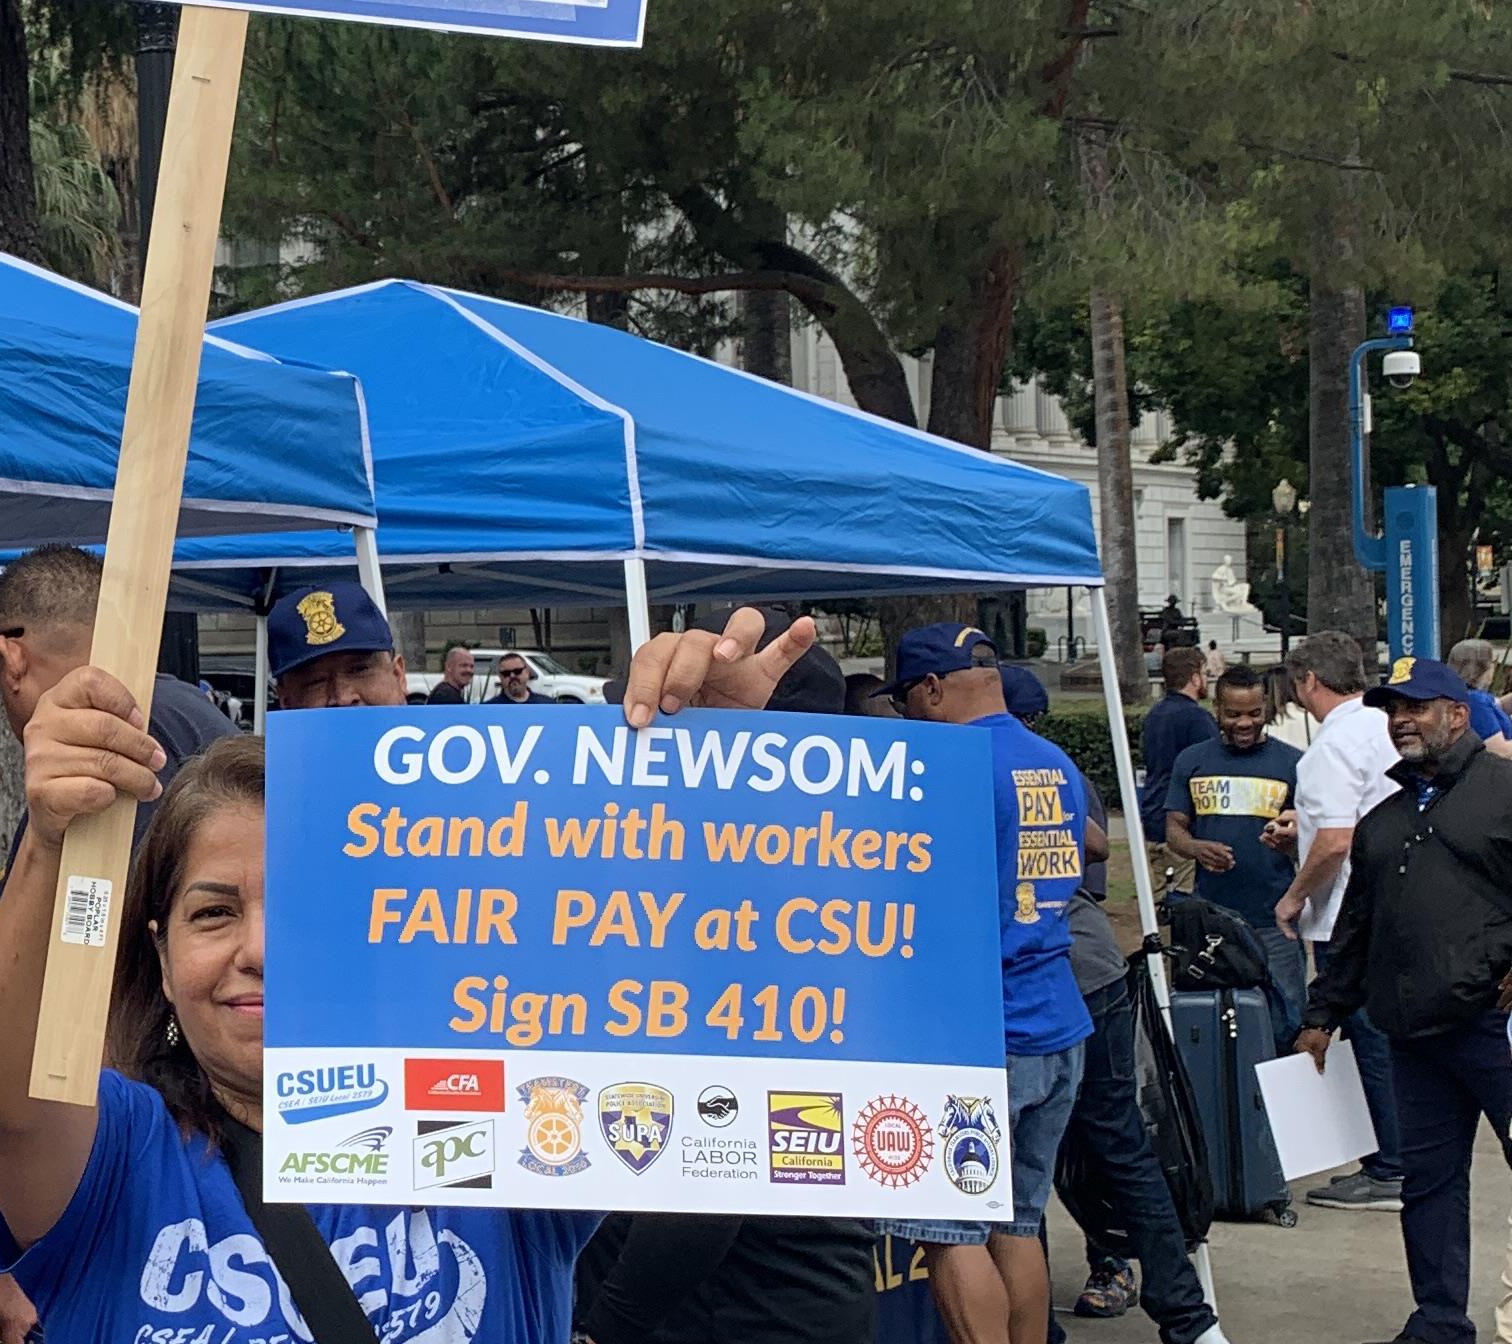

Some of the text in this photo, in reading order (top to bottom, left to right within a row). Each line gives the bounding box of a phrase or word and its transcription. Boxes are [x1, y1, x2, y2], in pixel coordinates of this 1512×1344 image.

[373, 725, 925, 802] GOV. NEWSOM:
[1191, 780, 1231, 794] TEAM
[1021, 790, 1059, 823] PAY
[342, 801, 933, 873] Stand with workers
[1019, 850, 1077, 876] WORK
[367, 888, 915, 959] FAIR PAY at CSU!
[449, 976, 846, 1047] Sign SB 410!
[277, 1063, 375, 1097] CSUEU
[447, 1074, 479, 1091] CFA
[608, 1123, 662, 1142] SUPA
[681, 1136, 757, 1149] California
[772, 1131, 841, 1153] SEIU
[876, 1130, 911, 1152] UAW
[279, 1152, 389, 1174] AFSCME
[421, 1130, 487, 1177] apc
[682, 1149, 758, 1165] LABOR
[782, 1156, 833, 1167] California
[278, 1176, 388, 1186] We Make California Happen
[682, 1167, 758, 1180] Federation
[774, 1170, 842, 1181] Stronger Together
